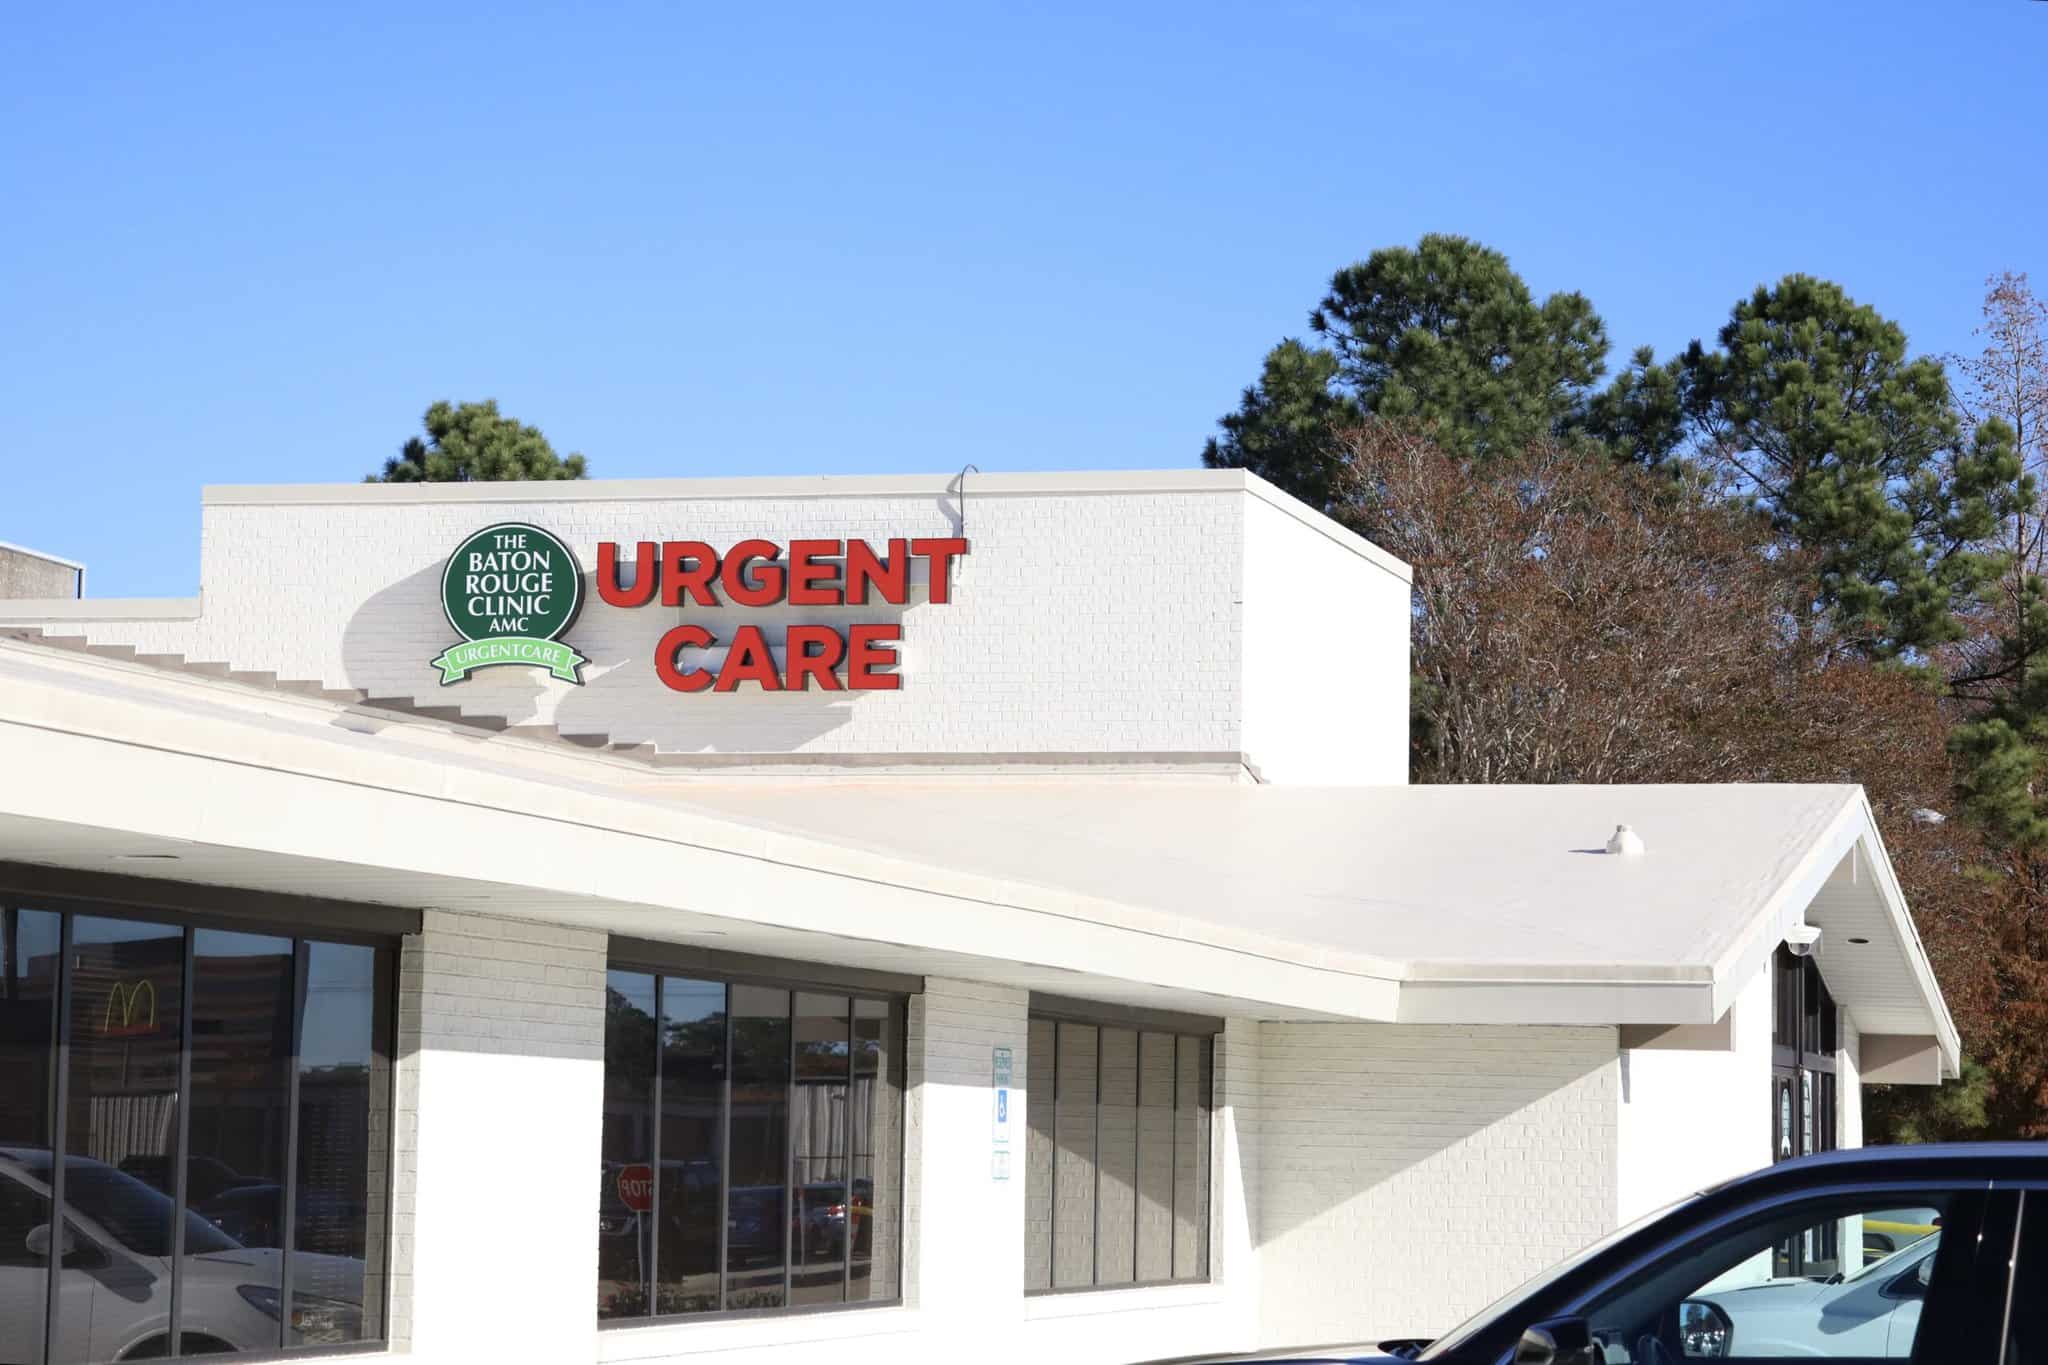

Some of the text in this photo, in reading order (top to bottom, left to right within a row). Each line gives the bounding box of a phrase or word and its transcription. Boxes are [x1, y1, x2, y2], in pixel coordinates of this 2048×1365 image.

[494, 534, 527, 549] THE
[469, 550, 550, 572] BATON
[466, 573, 553, 594] ROUGE
[596, 538, 968, 608] URGENT
[468, 595, 550, 616] CLINIC
[489, 617, 529, 632] AMC
[654, 624, 901, 692] CARE
